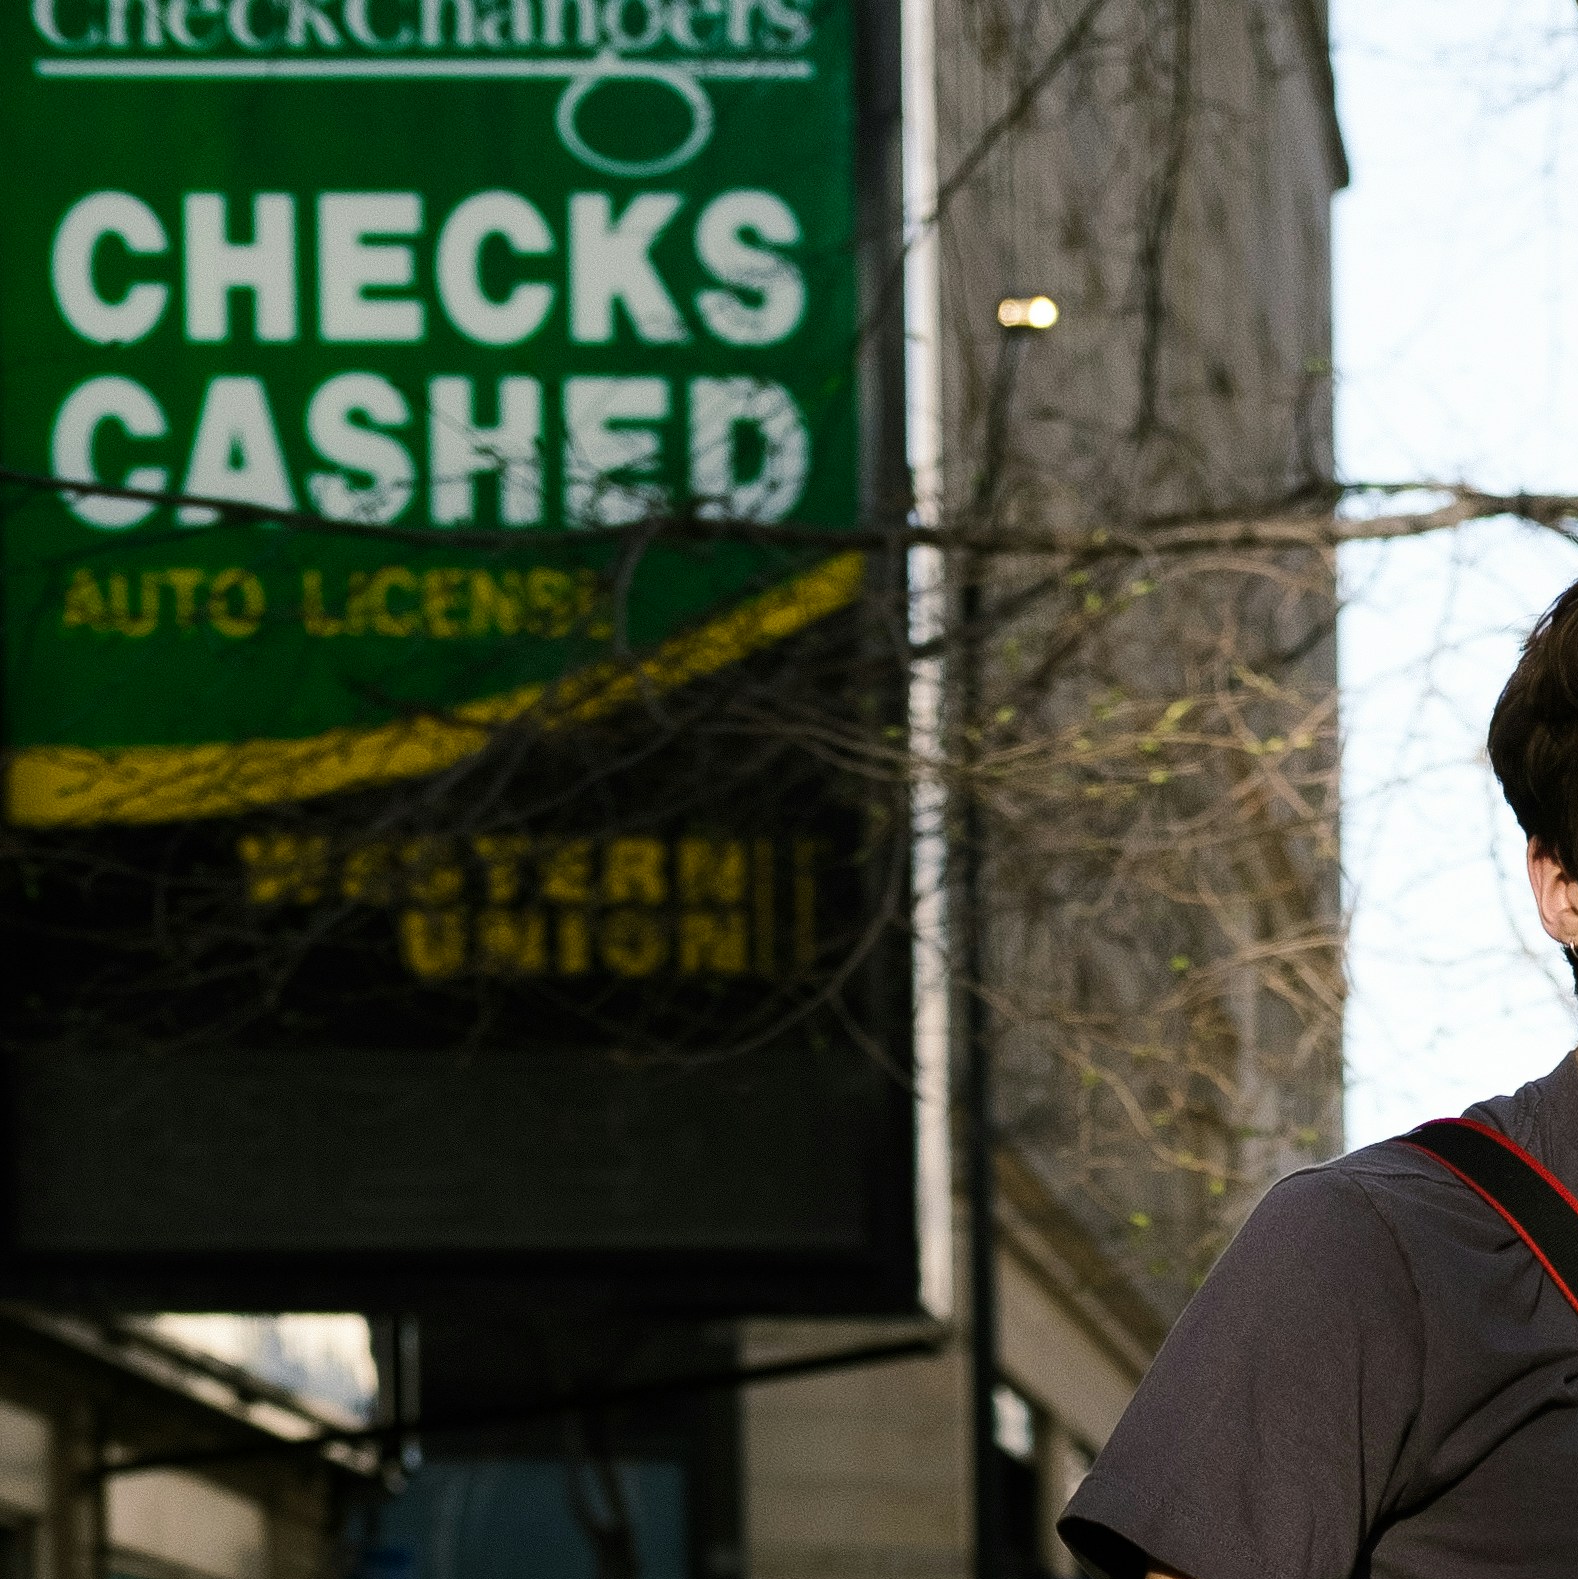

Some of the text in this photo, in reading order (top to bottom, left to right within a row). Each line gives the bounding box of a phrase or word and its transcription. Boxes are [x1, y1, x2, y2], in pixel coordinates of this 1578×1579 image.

[51, 190, 806, 346] CHECKS
[51, 372, 809, 530] CASHED
[62, 568, 266, 638] AUTO
[400, 910, 748, 978] UNION
